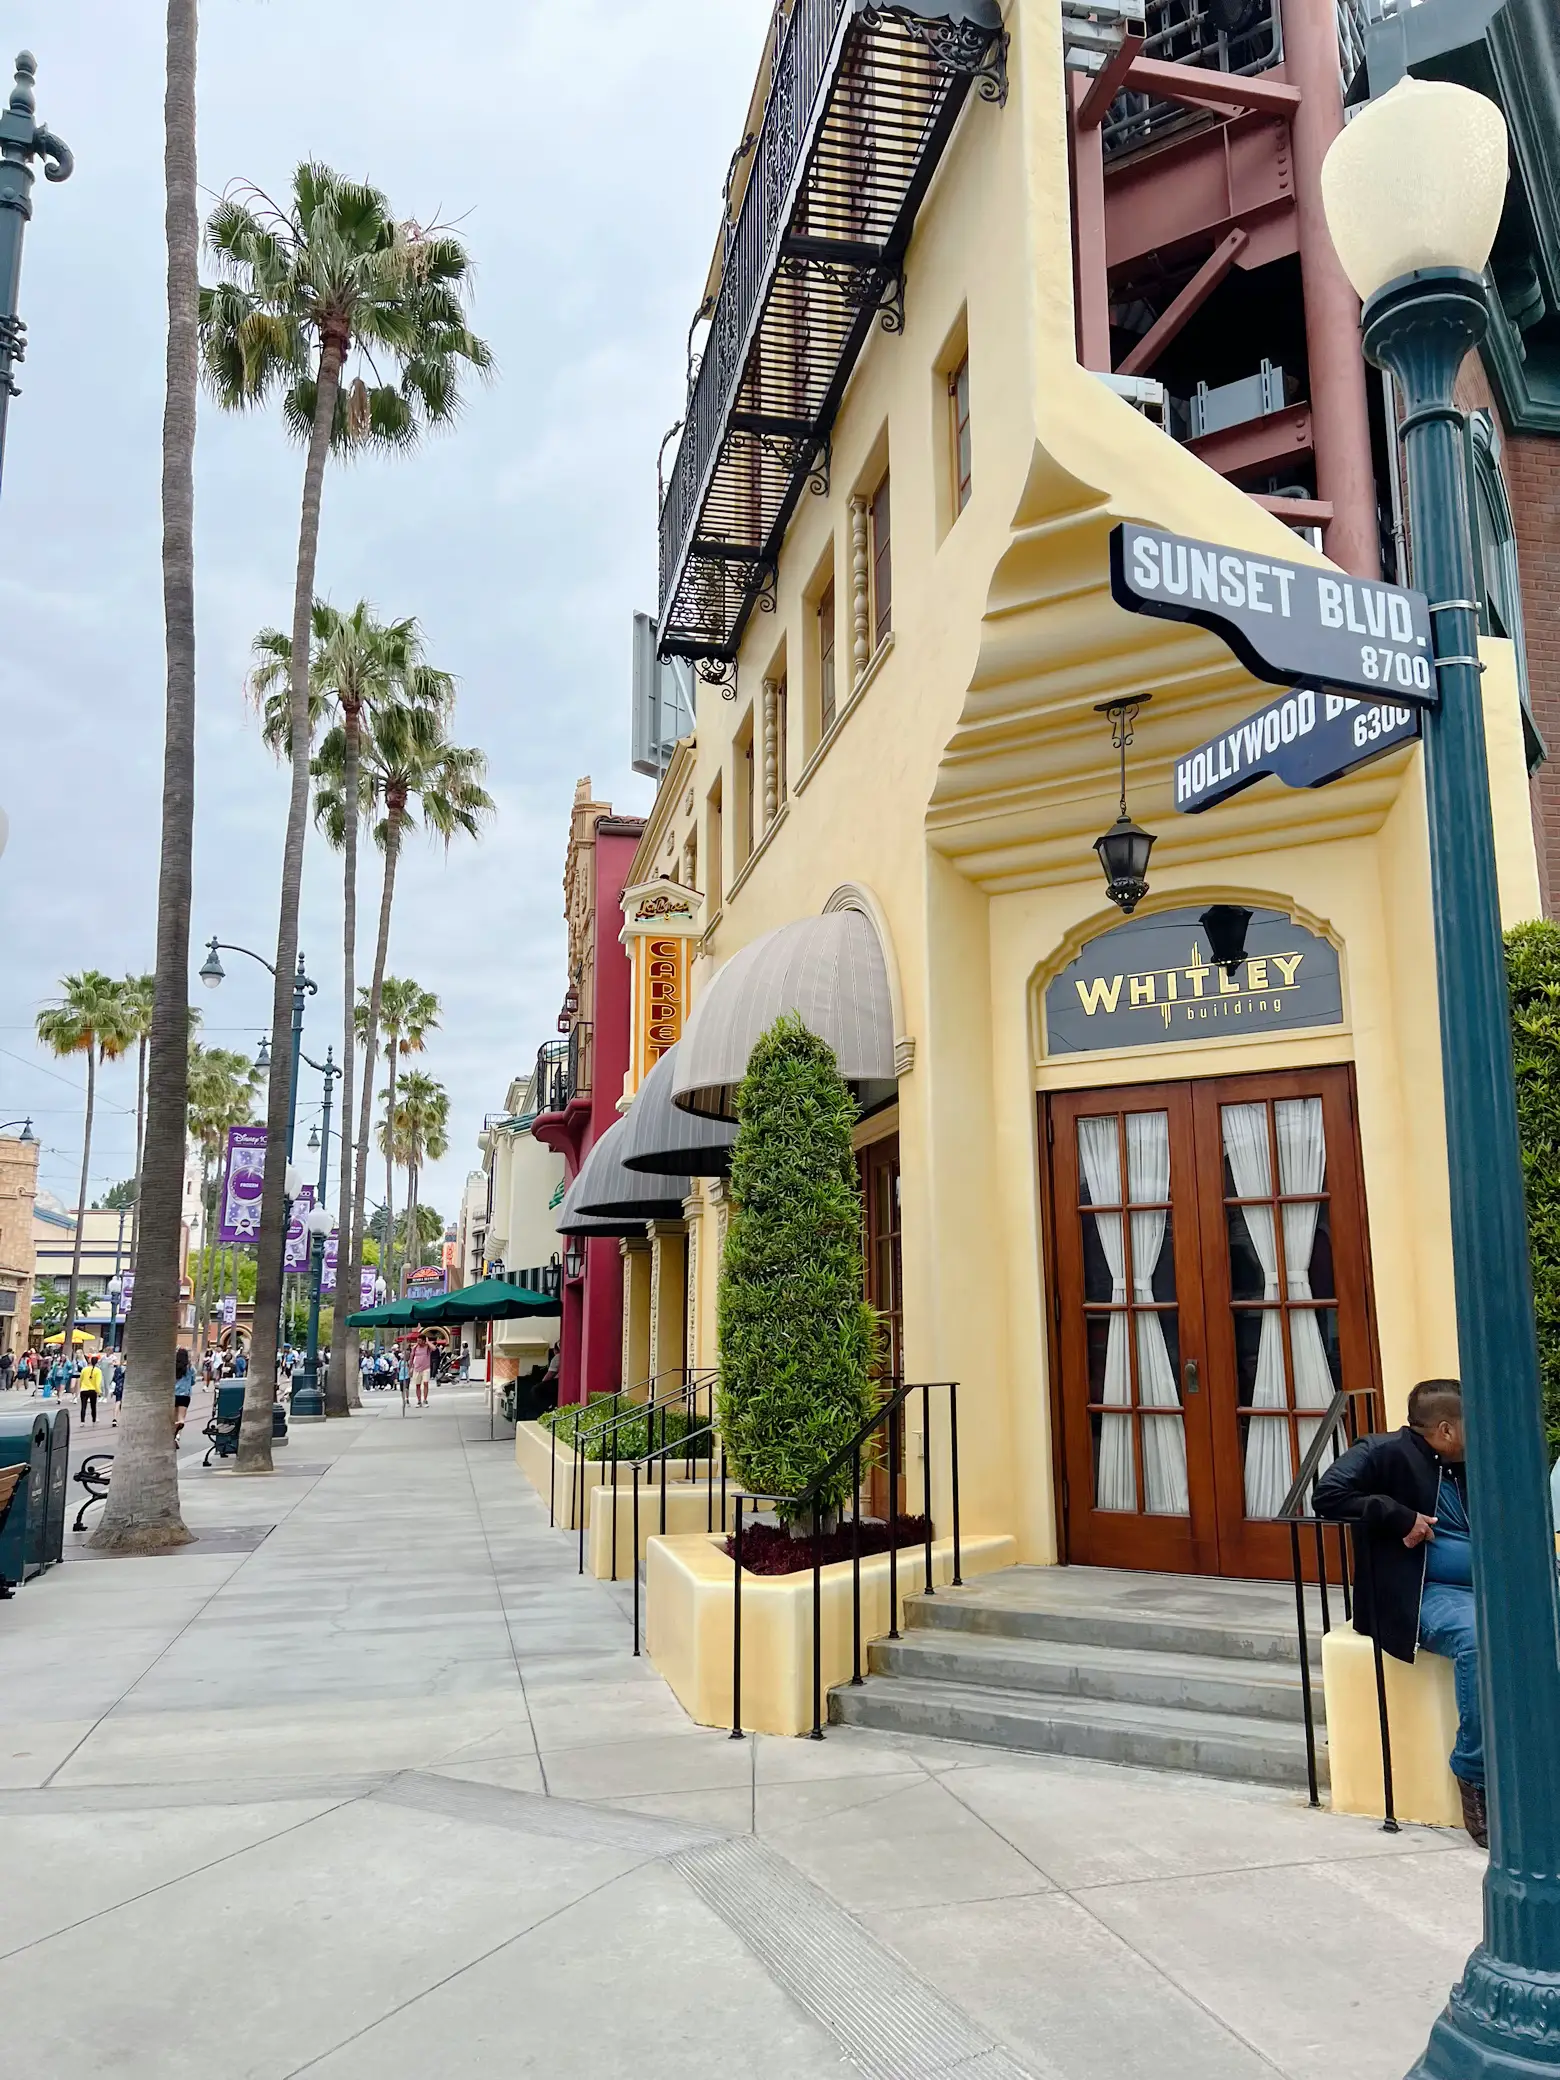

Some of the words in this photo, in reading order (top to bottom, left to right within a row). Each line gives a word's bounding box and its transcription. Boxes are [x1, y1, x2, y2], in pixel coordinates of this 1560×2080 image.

[1132, 535, 1296, 618] SUNSET
[1317, 577, 1427, 647] BLVD.
[1360, 645, 1431, 690] 8700
[1177, 690, 1317, 803] HOLLYWOOD
[1353, 703, 1411, 747] 6300
[1075, 955, 1304, 1016] WHITLEY
[1187, 998, 1282, 1020] building
